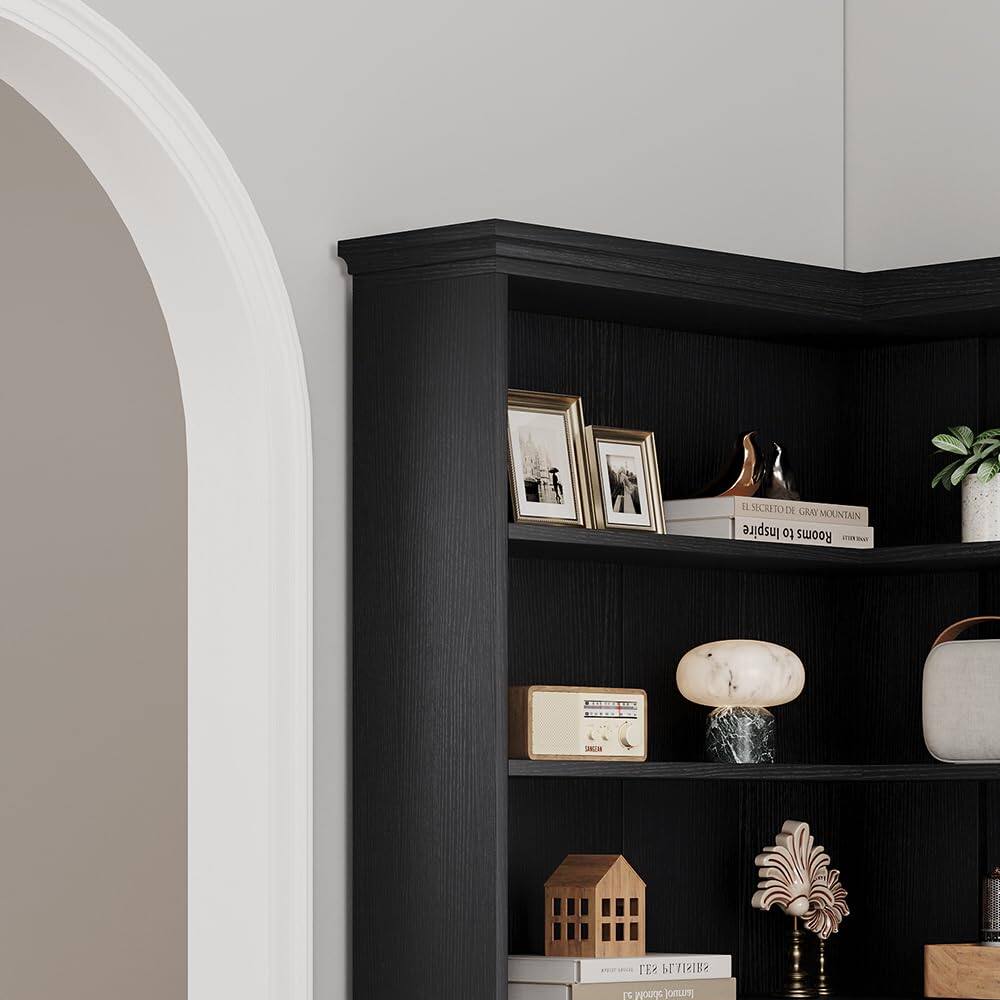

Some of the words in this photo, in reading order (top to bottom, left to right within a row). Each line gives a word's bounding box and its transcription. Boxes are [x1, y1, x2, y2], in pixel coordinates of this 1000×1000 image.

[742, 503, 749, 511] EL
[752, 503, 784, 514] SECRETO
[785, 506, 795, 514] DE
[799, 508, 818, 517] GRAY
[820, 509, 861, 520] MOUNTAIN
[743, 522, 779, 539] Inspire
[783, 528, 794, 540] to
[797, 530, 832, 544] Rooms
